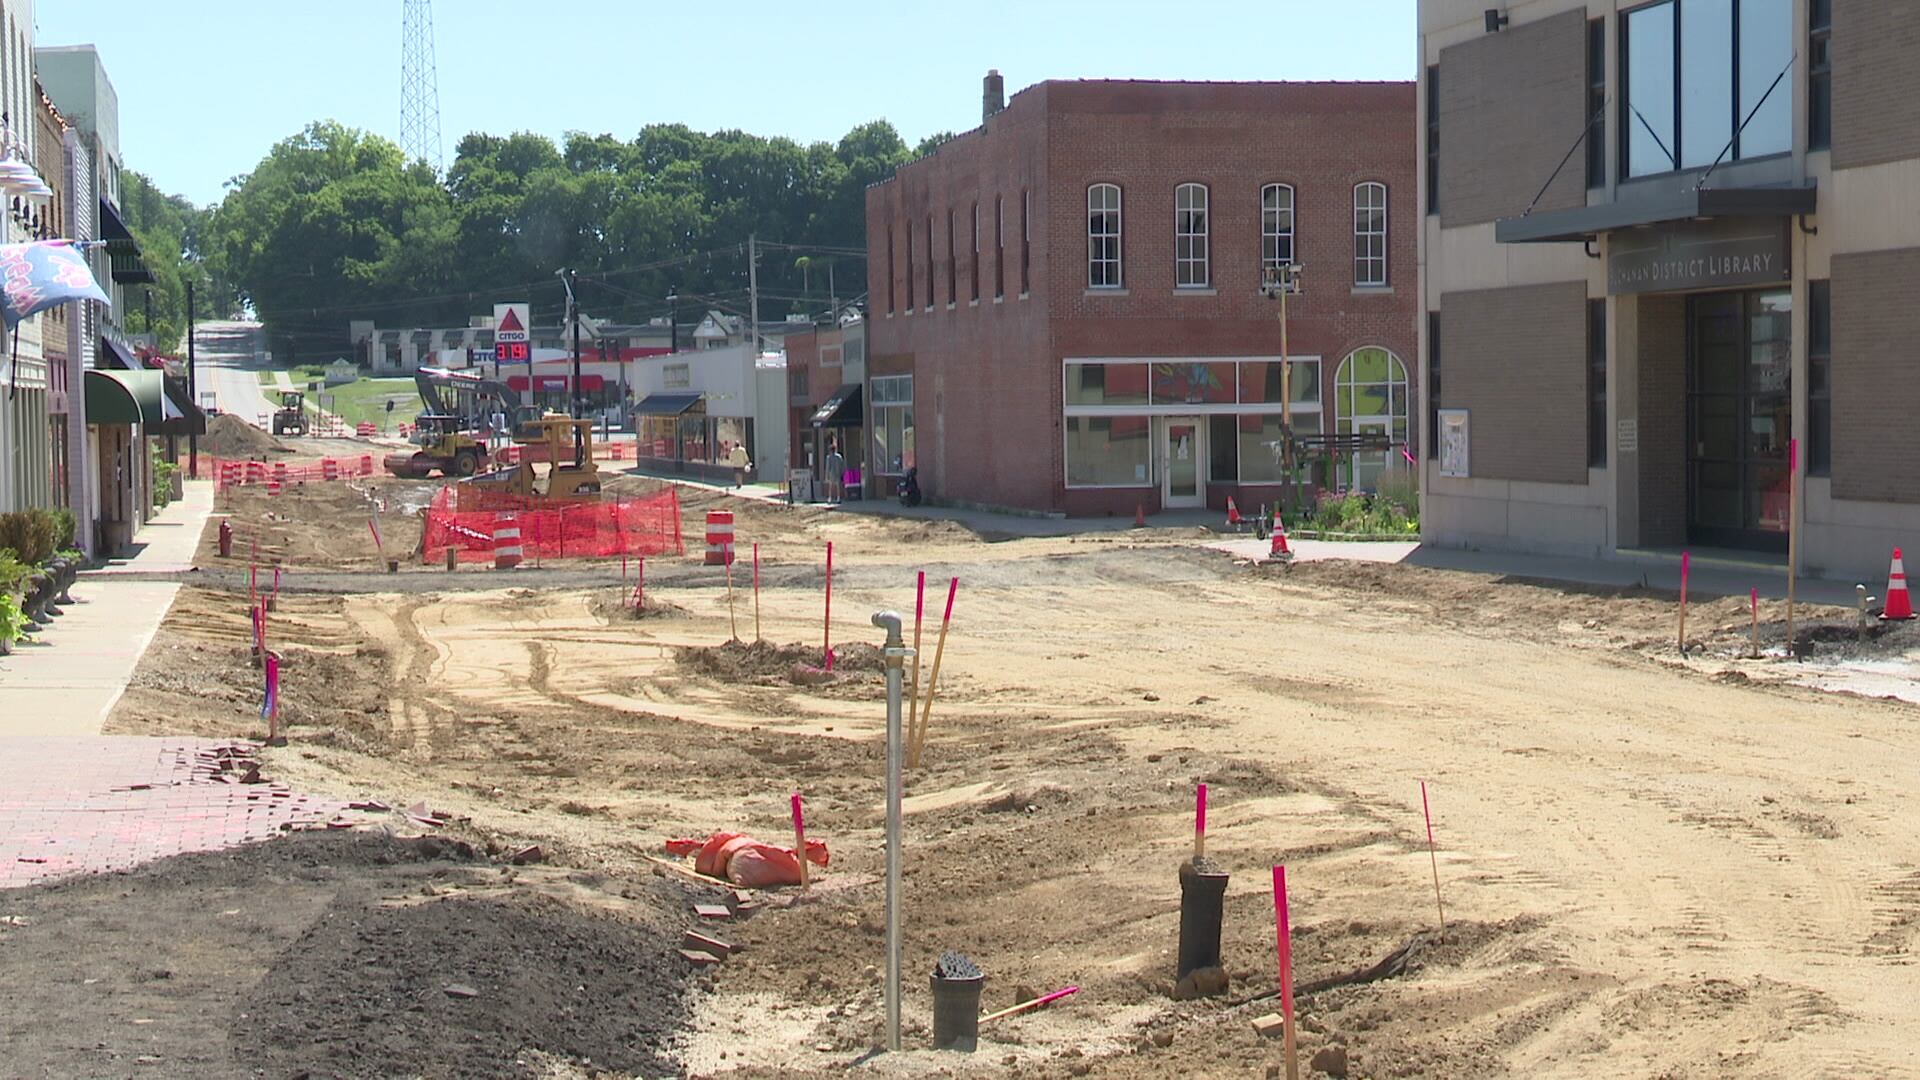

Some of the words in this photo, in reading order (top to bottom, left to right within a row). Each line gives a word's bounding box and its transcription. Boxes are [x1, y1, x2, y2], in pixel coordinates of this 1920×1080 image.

[1652, 258, 1705, 281] DISTRICT
[1709, 254, 1773, 275] LIBRARY
[498, 332, 525, 340] CITGO
[451, 380, 476, 390] DEERE
